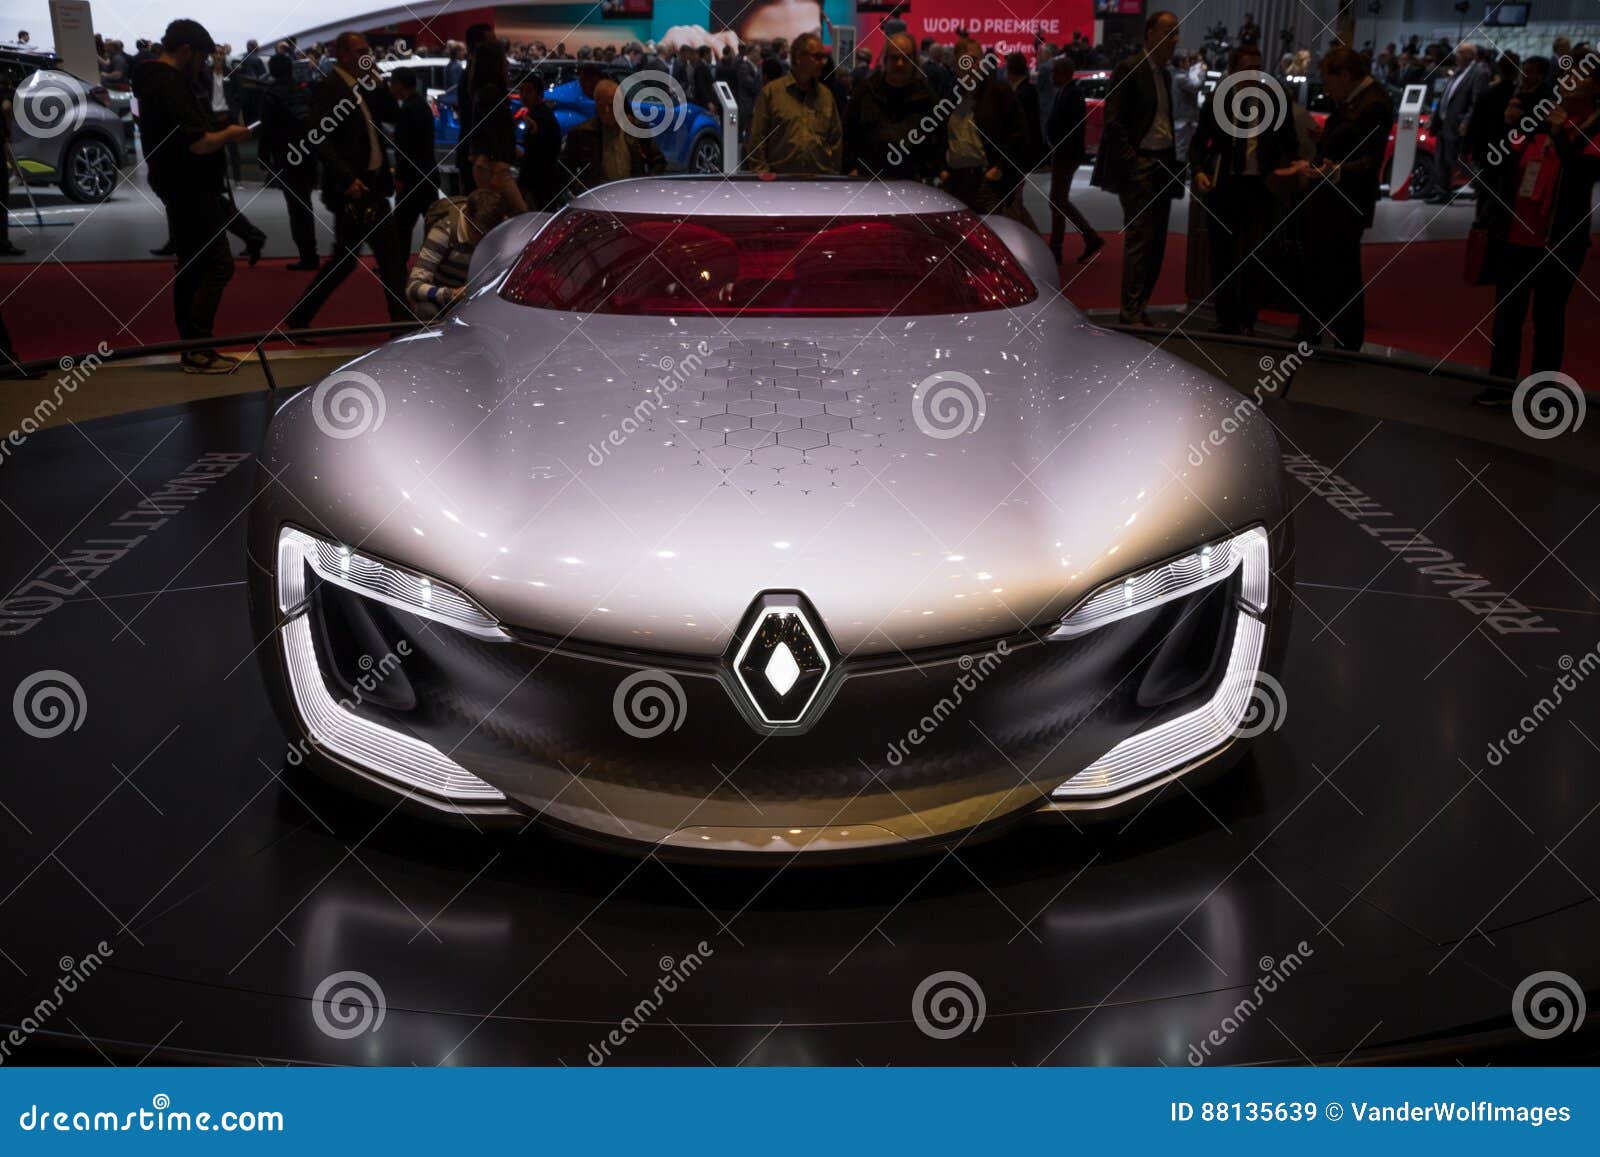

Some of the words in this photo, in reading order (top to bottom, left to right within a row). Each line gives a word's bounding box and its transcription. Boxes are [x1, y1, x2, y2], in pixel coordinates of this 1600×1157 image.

[923, 18, 981, 33] WORLD
[984, 18, 1060, 34] PREMIERE
[110, 453, 252, 530] RENAULT
[1359, 523, 1560, 634] RENAULT
